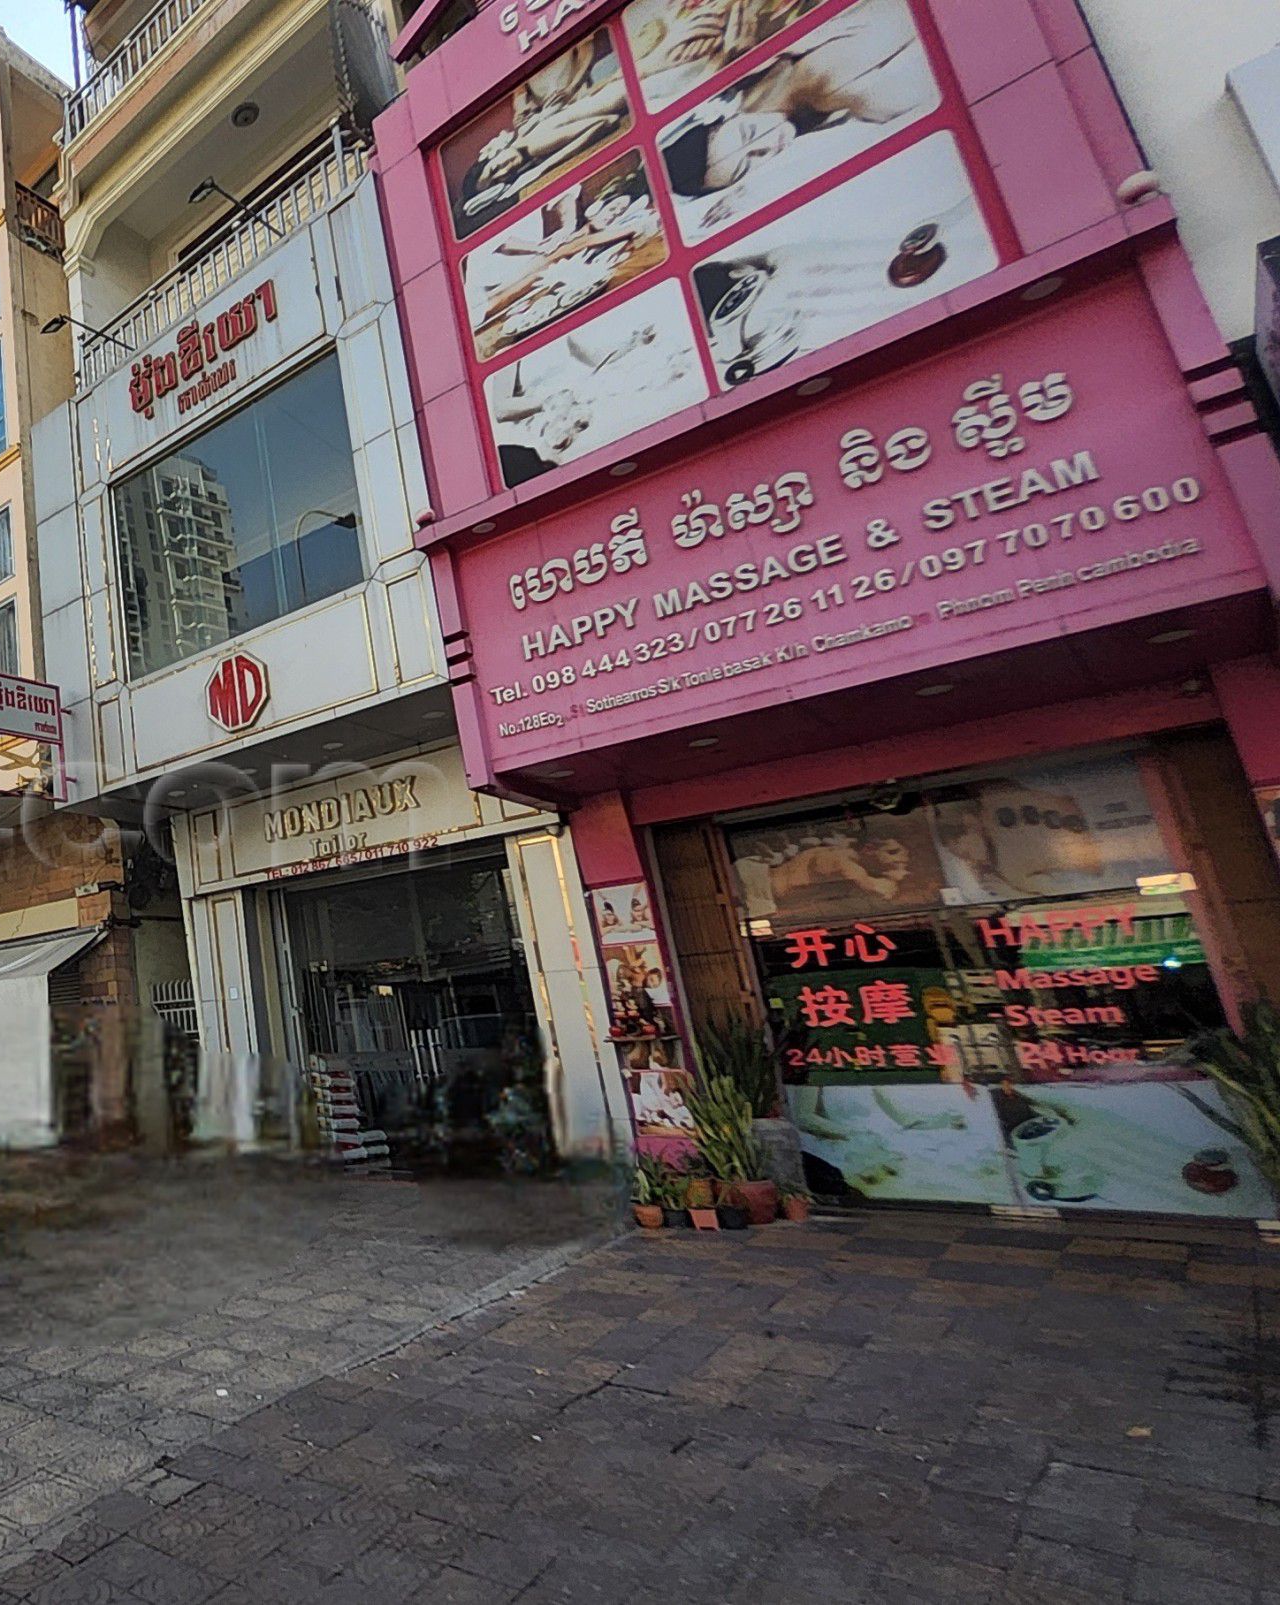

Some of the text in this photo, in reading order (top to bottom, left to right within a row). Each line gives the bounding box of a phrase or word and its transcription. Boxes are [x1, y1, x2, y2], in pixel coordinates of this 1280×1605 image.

[839, 427, 932, 490] និង
[522, 450, 1101, 661] HAPPY MASSAGE & STEAM
[490, 684, 528, 705] Tel.
[532, 665, 576, 693] 098
[581, 649, 631, 678] 444
[763, 597, 803, 626] 26
[810, 583, 845, 610] 11
[208, 654, 264, 729] MD
[263, 775, 421, 843] MONDIAUX
[310, 831, 368, 859] Tailor
[785, 922, 898, 969] 开心
[975, 903, 1137, 948] HAPPY
[797, 979, 917, 1028] 按摩
